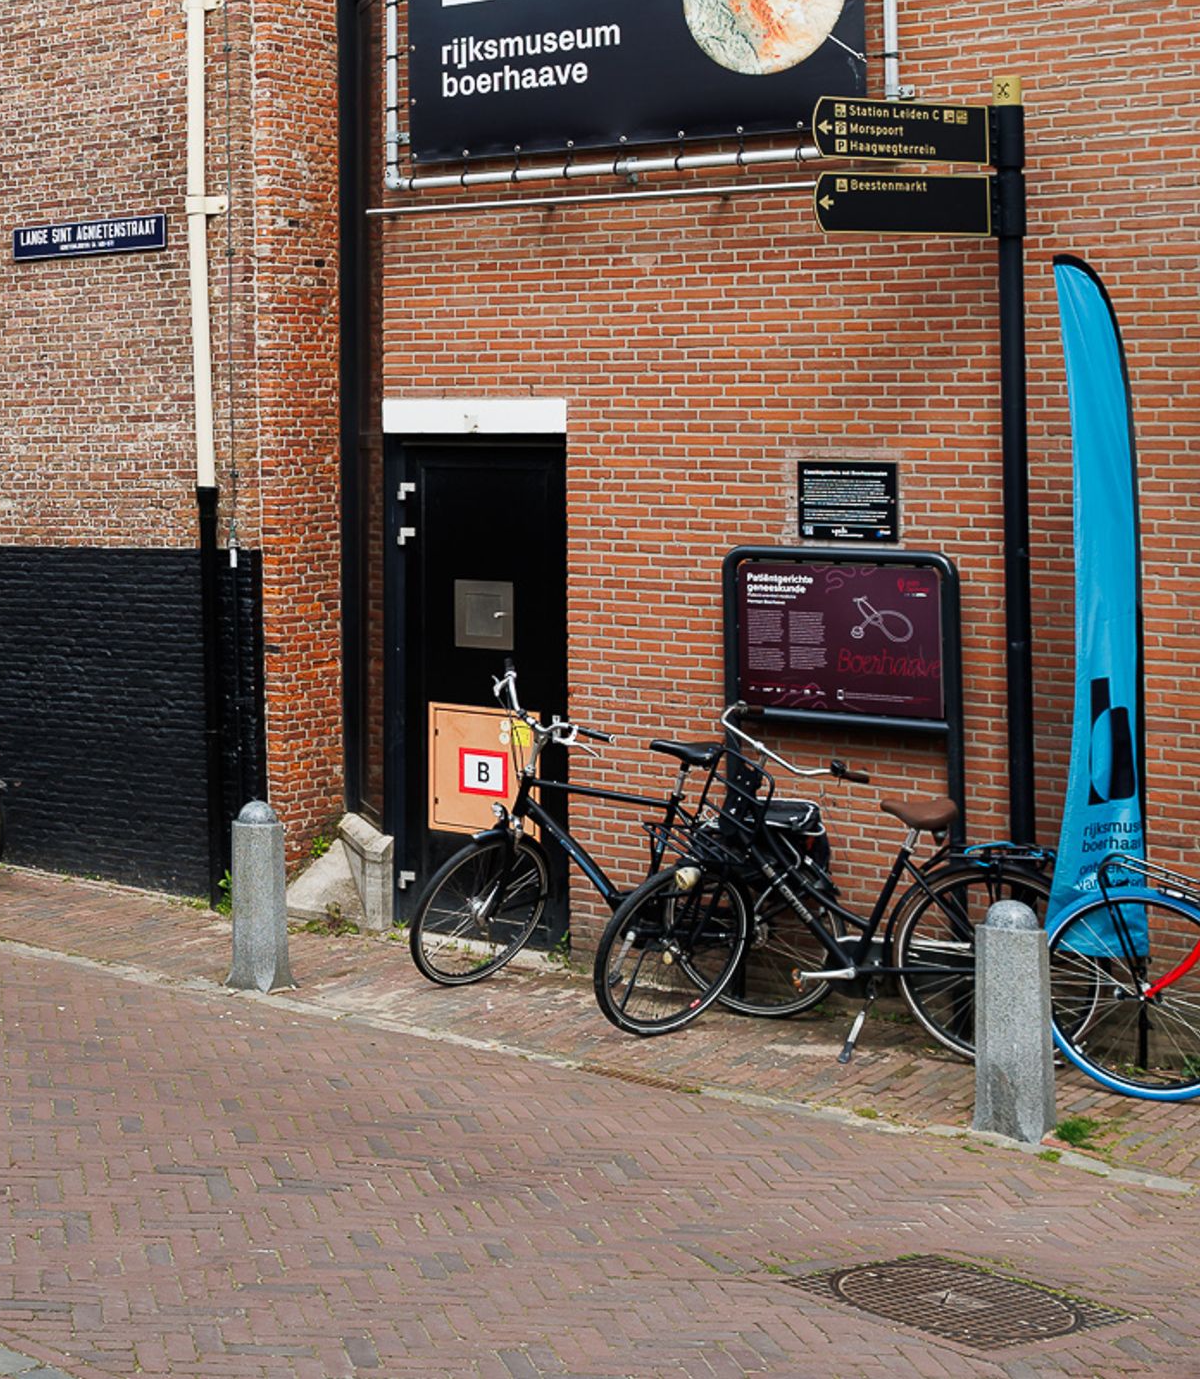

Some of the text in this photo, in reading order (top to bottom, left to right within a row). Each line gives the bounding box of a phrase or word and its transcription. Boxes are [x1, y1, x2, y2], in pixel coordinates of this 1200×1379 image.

[441, 22, 621, 69] rijksmuseum
[442, 60, 588, 97] boerhaave
[848, 105, 940, 120] Station Leiden C
[849, 123, 904, 137] Morspoort
[849, 141, 937, 155] Haagwegterrein
[850, 178, 928, 192] Beestenmarkt
[20, 229, 49, 246] LANGE
[52, 227, 73, 244] SINT
[76, 219, 157, 241] AGNIETENSTRAAT
[478, 761, 490, 783] B
[1083, 822, 1141, 839] rijksmus
[1082, 836, 1141, 853] boerhaa
